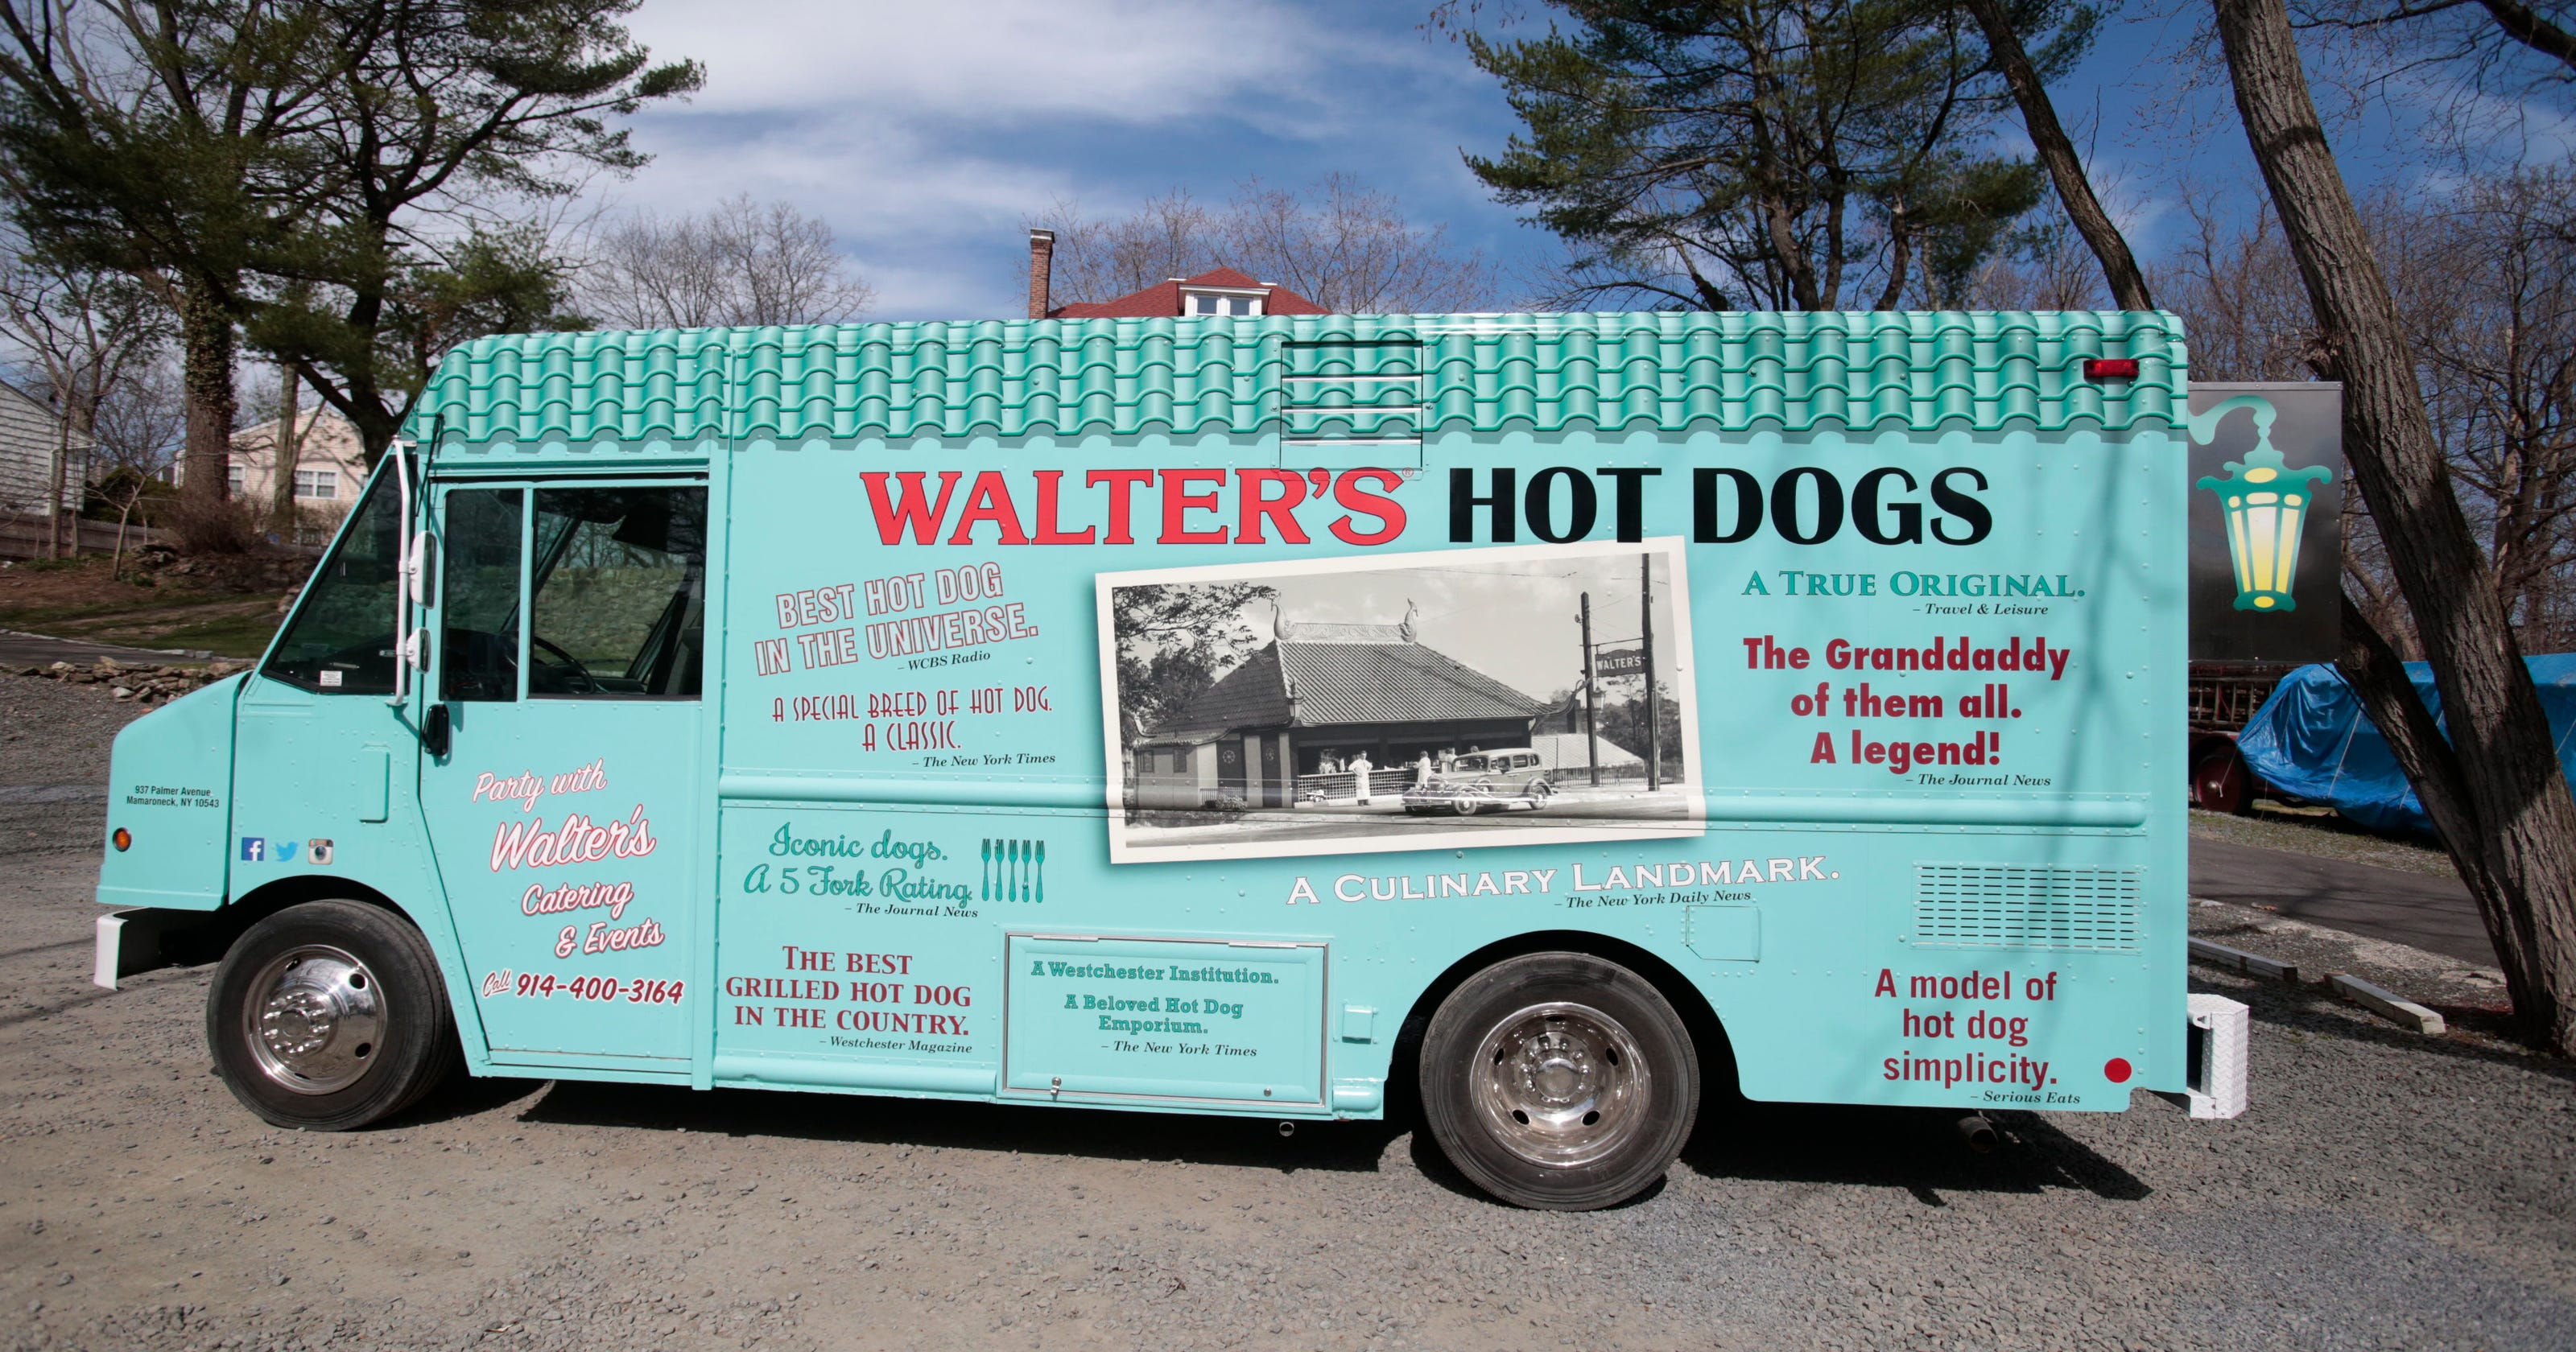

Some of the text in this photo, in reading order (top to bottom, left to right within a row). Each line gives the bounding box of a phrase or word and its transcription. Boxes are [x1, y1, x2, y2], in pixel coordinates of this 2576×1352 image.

[1449, 466, 1662, 544] HOT
[1692, 466, 1992, 546] DOGS
[776, 562, 1003, 629] BEST HOT DOG
[1741, 571, 1770, 596] A
[1925, 603, 1971, 615] Travel
[1977, 604, 1989, 615] &
[1994, 604, 2049, 616] Leisure
[754, 603, 1038, 676] IN THE UNIVERSE.
[908, 655, 947, 671] WCBS
[951, 650, 991, 665] Radio
[1596, 656, 1641, 671] WALTER'S
[1743, 635, 2070, 681] The Granddaddy
[772, 686, 1052, 722] A SPECIAL BREED OF HOT DOG.
[1791, 682, 2021, 719] of them all.
[862, 720, 961, 752] A CLASSIC.
[923, 756, 947, 768] The
[951, 756, 977, 766] New
[982, 754, 1012, 765] York
[1016, 752, 1056, 765] Times
[1810, 729, 2000, 775] A legend!
[135, 785, 211, 797] 937 Palmer Avenue
[472, 757, 608, 814] Party with
[1918, 773, 1943, 785] The
[1948, 773, 2008, 786] Journal
[2013, 775, 2051, 786] News
[126, 796, 220, 808] Mamaroneck, NY 10543
[490, 803, 657, 872] Walter's
[769, 822, 948, 869] Iconic dogs.
[522, 881, 634, 920] Catering
[744, 863, 972, 909] A 5 Fork Rating
[1286, 876, 1320, 905] A
[1567, 896, 1594, 908] The
[1597, 895, 1629, 907] New
[1632, 893, 1666, 905] York
[1670, 891, 1708, 905] Daily
[1713, 889, 1751, 901] News
[857, 903, 881, 914] The
[884, 904, 939, 917] Journal
[943, 906, 978, 918] News
[555, 917, 665, 958] & Events
[846, 953, 913, 975] BEST
[1030, 961, 1279, 984] A Westchester Institution.
[483, 969, 684, 1004] Call 914-400-3164
[725, 976, 972, 1007] GRILLED HOT DOG
[1875, 968, 2057, 1001] A model of
[734, 1005, 969, 1036] IN THE COUNTRY.
[1064, 995, 1243, 1019] A Beloved Hot Dog
[1099, 1016, 1208, 1035] Emporium.
[1903, 1008, 2029, 1047] hot dog
[830, 1036, 906, 1050] Westchester
[908, 1040, 972, 1054] Magazine
[1113, 1041, 1140, 1052] The
[1144, 1042, 1172, 1053] New
[1178, 1043, 1209, 1055] York
[1215, 1044, 1257, 1057] Times
[1883, 1050, 2058, 1091] simplicity.
[1984, 1090, 2041, 1103] Serious
[2046, 1091, 2080, 1104] Eats
